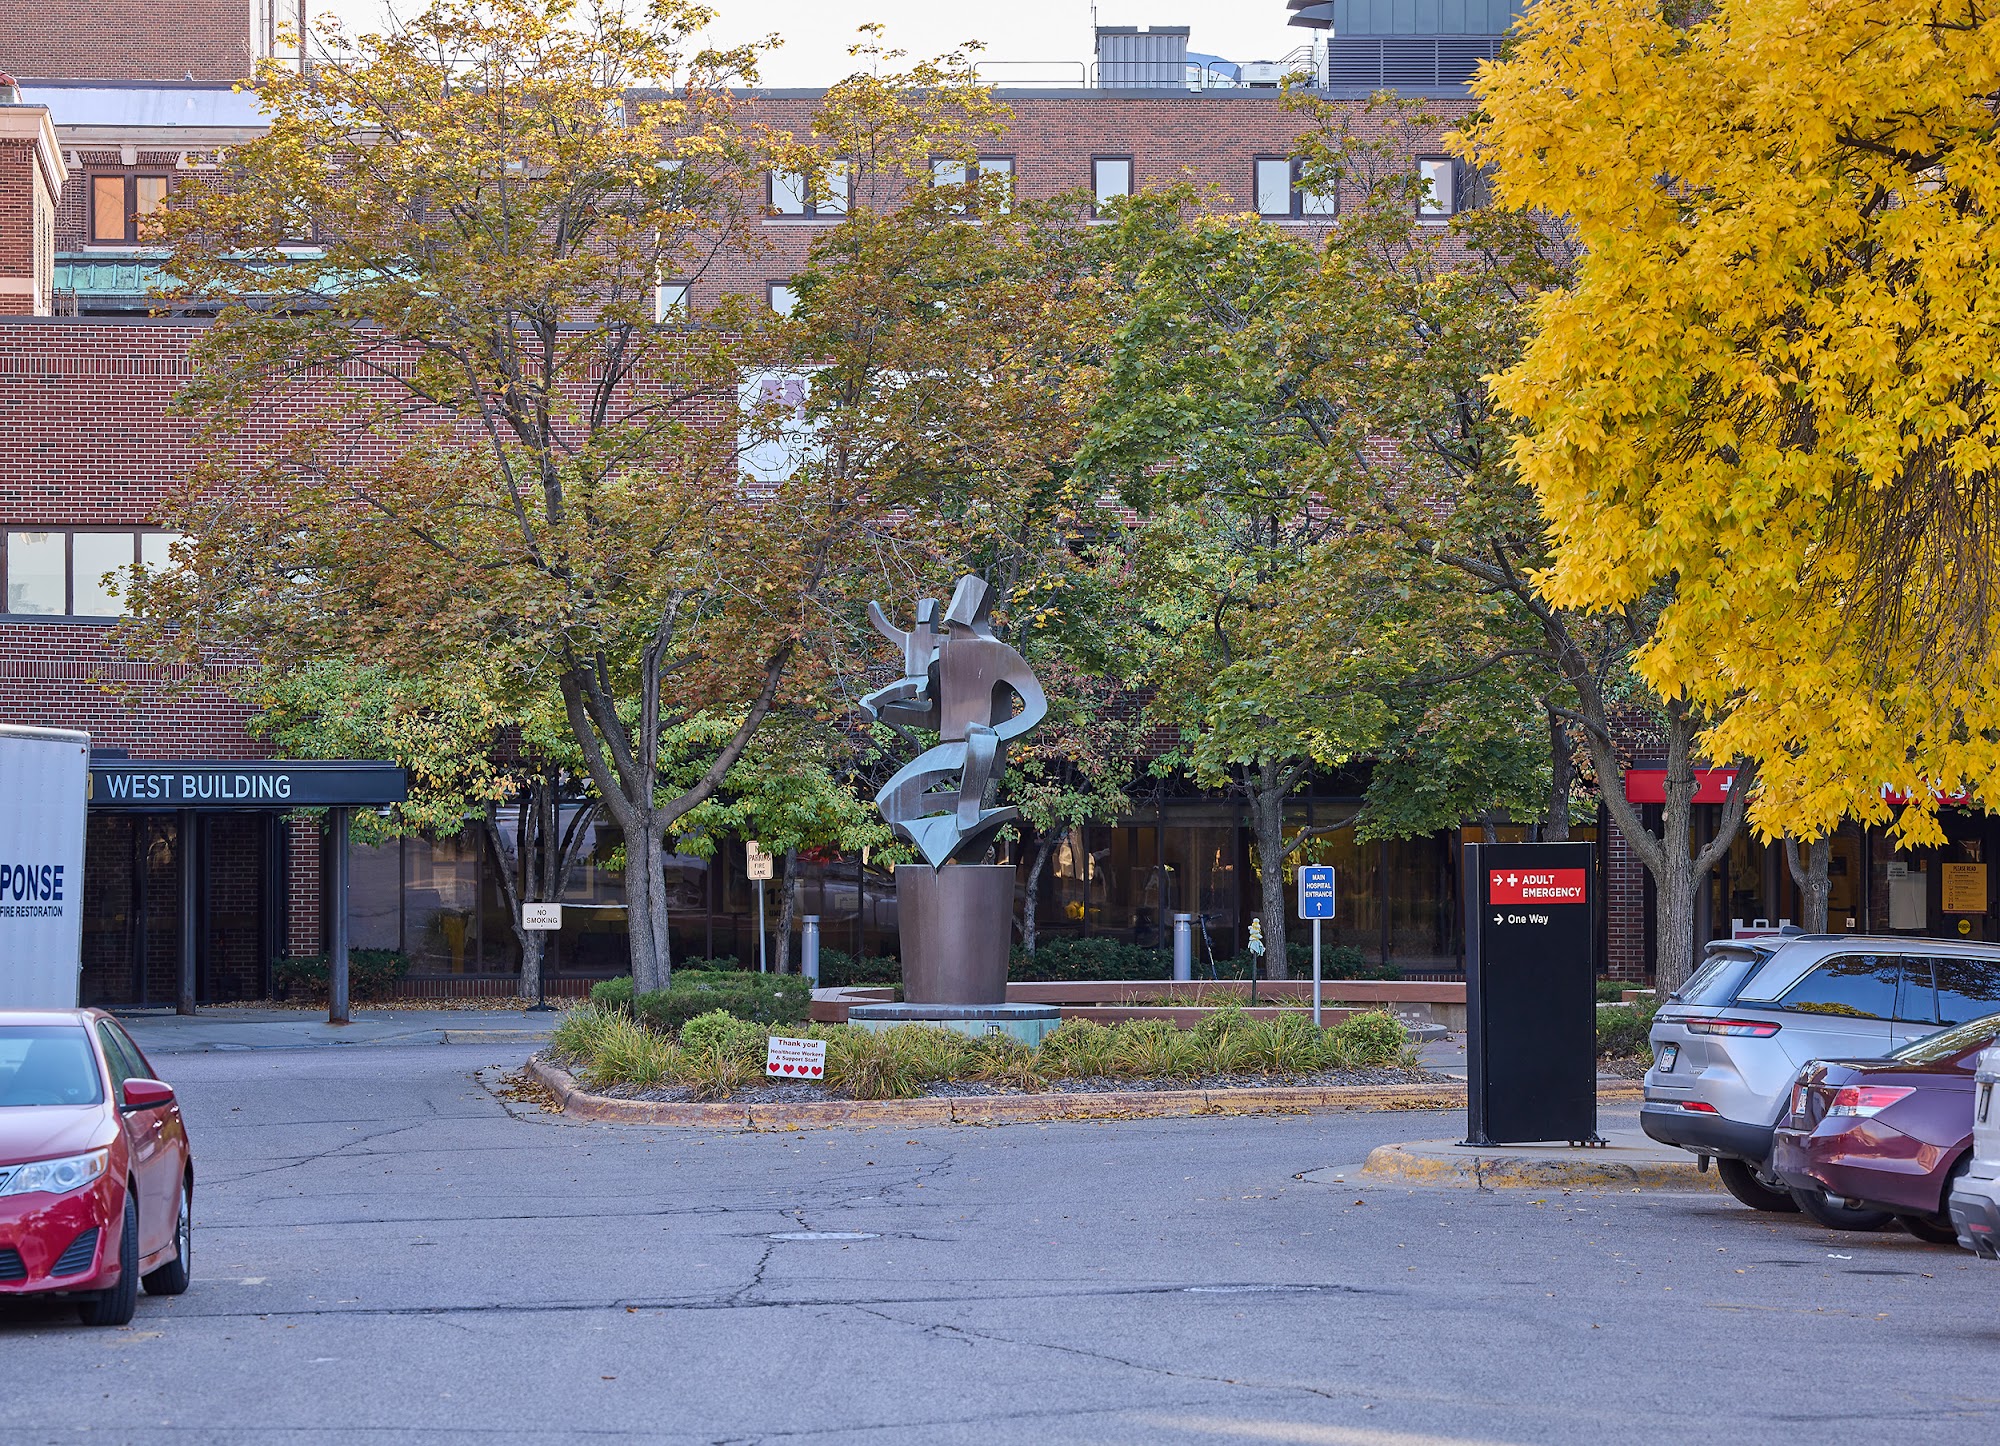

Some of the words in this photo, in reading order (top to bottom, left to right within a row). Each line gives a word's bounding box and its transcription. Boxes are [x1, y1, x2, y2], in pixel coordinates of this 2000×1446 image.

[106, 774, 175, 798] WEST
[182, 774, 291, 798] BUILDING
[0, 864, 64, 901] PONSE
[1522, 875, 1555, 885] ADULT
[1522, 887, 1581, 898] EMERGENCY
[0, 905, 15, 918] FIRE
[15, 905, 63, 918] RESTORATION
[1507, 914, 1527, 924] One
[1528, 914, 1549, 925] Way
[802, 1041, 818, 1049] you!
